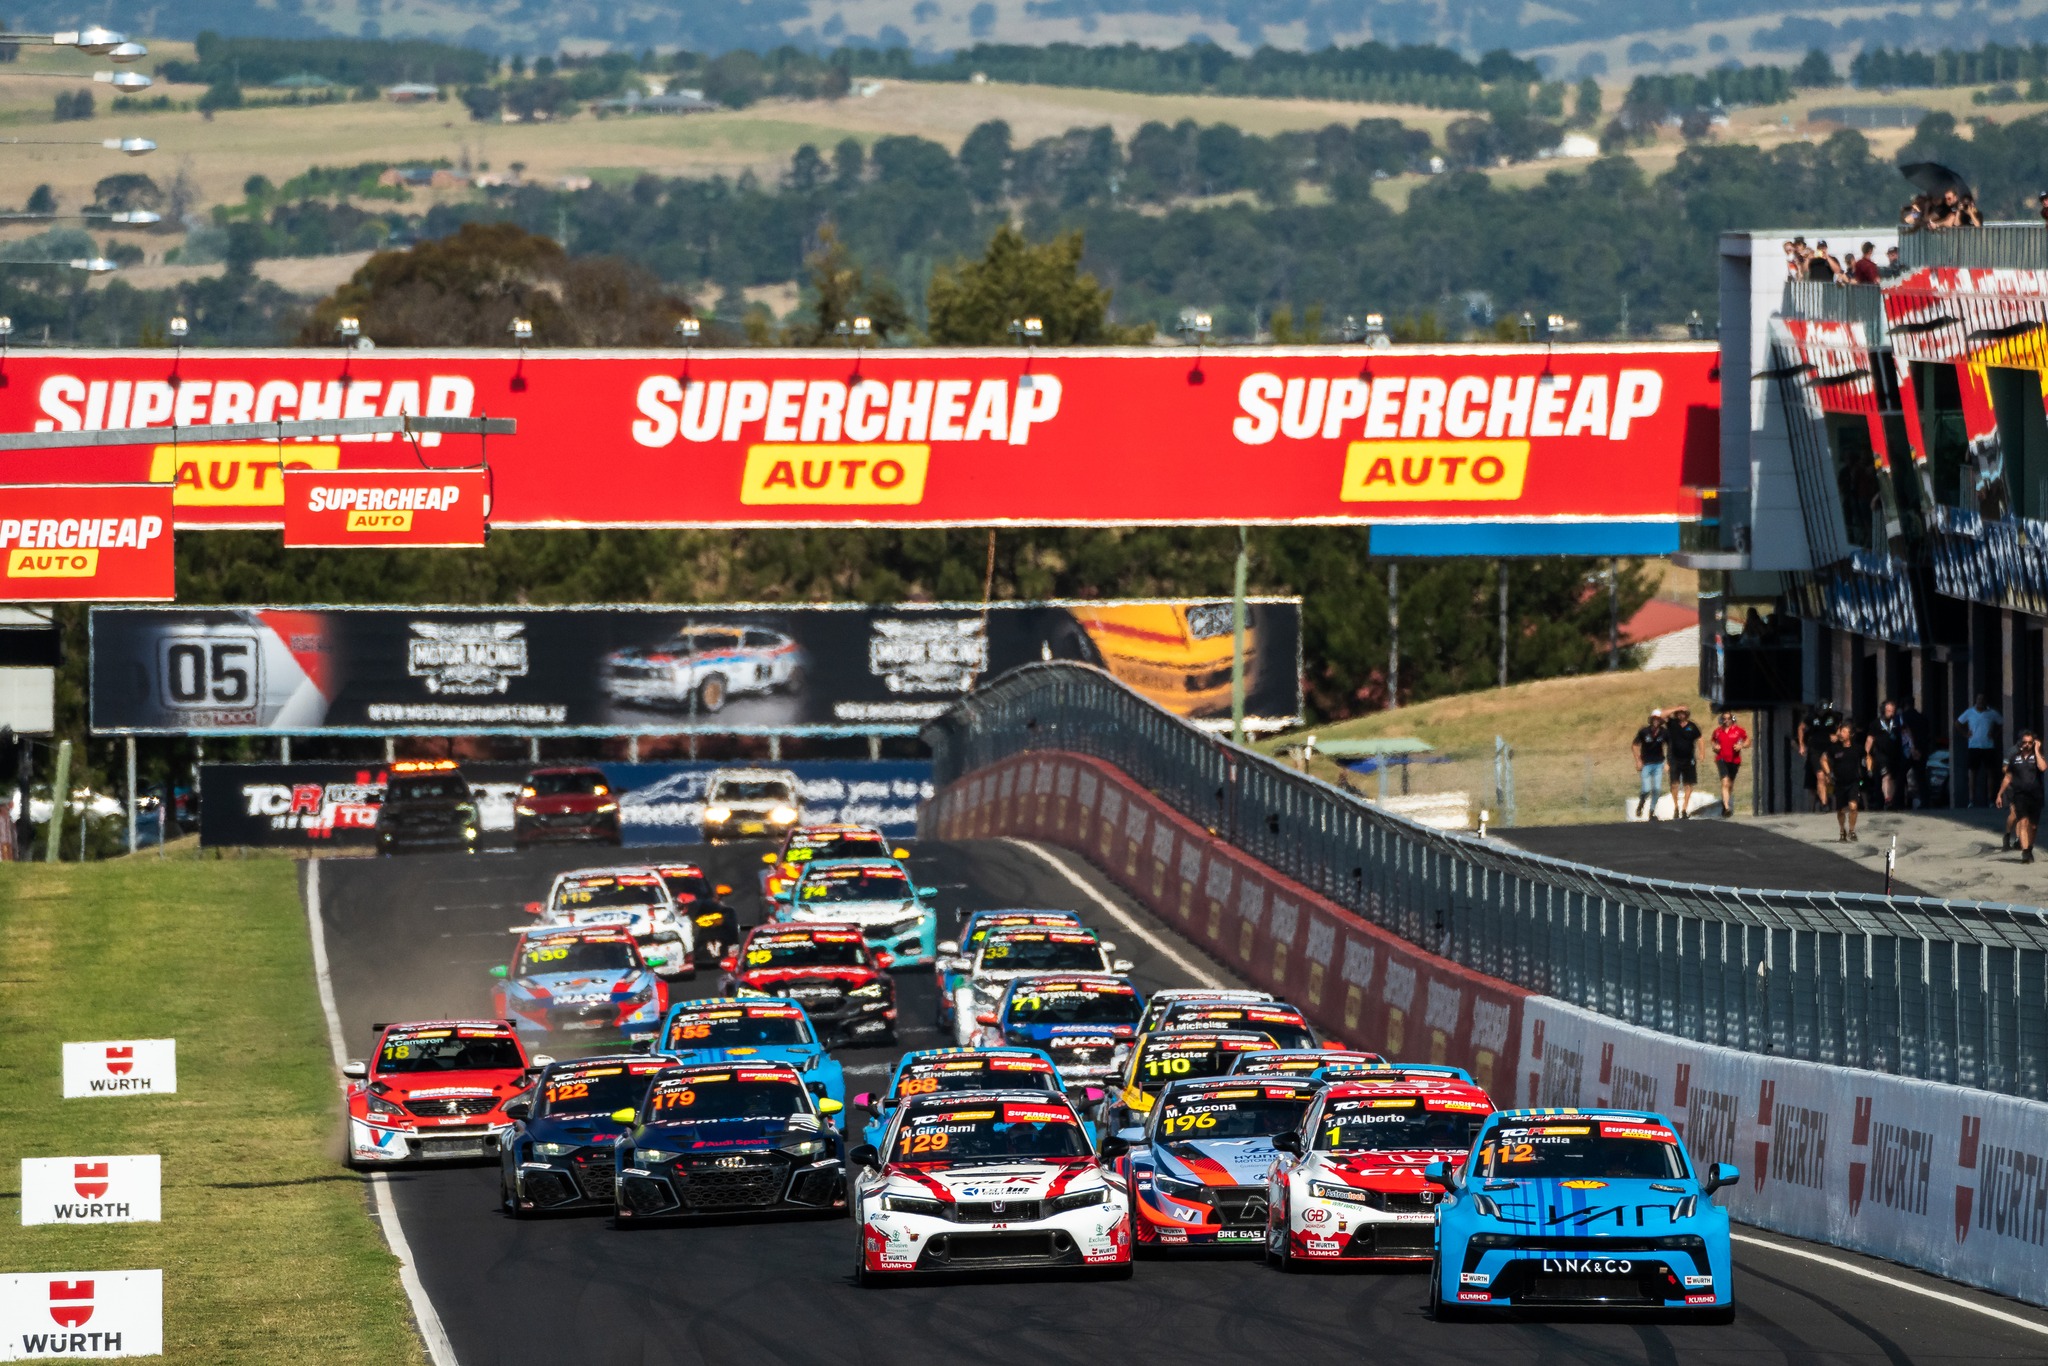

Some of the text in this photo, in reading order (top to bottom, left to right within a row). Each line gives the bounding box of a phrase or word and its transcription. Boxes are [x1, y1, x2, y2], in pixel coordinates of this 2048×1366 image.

[34, 375, 475, 447] SUPERCHEAP
[632, 374, 1062, 448] SUPERCHEAP
[1232, 369, 1662, 446] SUPERCHEAP
[175, 461, 313, 490] AUT
[762, 460, 905, 489] AUTO
[1363, 455, 1505, 486] AUTO
[308, 486, 460, 513] SUPERCHEAP
[354, 515, 405, 527] AUTO
[0, 515, 163, 550] PERCHEAP
[18, 556, 88, 570] AUTO
[168, 643, 249, 702] 05
[242, 782, 323, 816] TCR
[527, 948, 568, 963] 130
[1011, 996, 1041, 1011] 71
[671, 1024, 711, 1041] 155
[384, 1038, 445, 1049] A.Cameron
[1050, 1037, 1115, 1048] NULON
[383, 1045, 410, 1060] 18
[1144, 1058, 1191, 1076] 110
[90, 1077, 152, 1092] WÜRTH
[546, 1083, 589, 1103] 122
[898, 1078, 938, 1097] 168
[1347, 1088, 1467, 1096] HONDA
[652, 1091, 696, 1111] 179
[1178, 1092, 1218, 1104] TCR
[1334, 1100, 1375, 1112] TCR
[1428, 1099, 1489, 1109] SUPERCHEAP
[912, 1113, 954, 1126] TCR
[1007, 1110, 1070, 1121] SUPERCHEAP
[1166, 1103, 1237, 1119] M. Azcona
[901, 1123, 976, 1139] N.Girolami
[1163, 1112, 1217, 1136] 196
[1499, 1128, 1545, 1138] TCR
[1604, 1126, 1673, 1138] SUPERCHEAP
[1687, 1086, 1739, 1164] WÜRTH
[705, 1138, 769, 1147] Audi Sport
[899, 1132, 949, 1156] 129
[1325, 1126, 1341, 1147] 1
[1479, 1144, 1534, 1166] 112
[1773, 1103, 1829, 1190] WÜRTH
[1360, 1168, 1426, 1176] CIV
[1869, 1121, 1933, 1216] WÜRTH
[1325, 1188, 1366, 1201] Astrontech
[1978, 1143, 2048, 1247] WÜRTH
[54, 1202, 130, 1219] WÜRTH
[1307, 1209, 1324, 1222] GB
[1217, 1230, 1261, 1238] BRC GAS
[22, 1331, 122, 1354] WÜRTH
